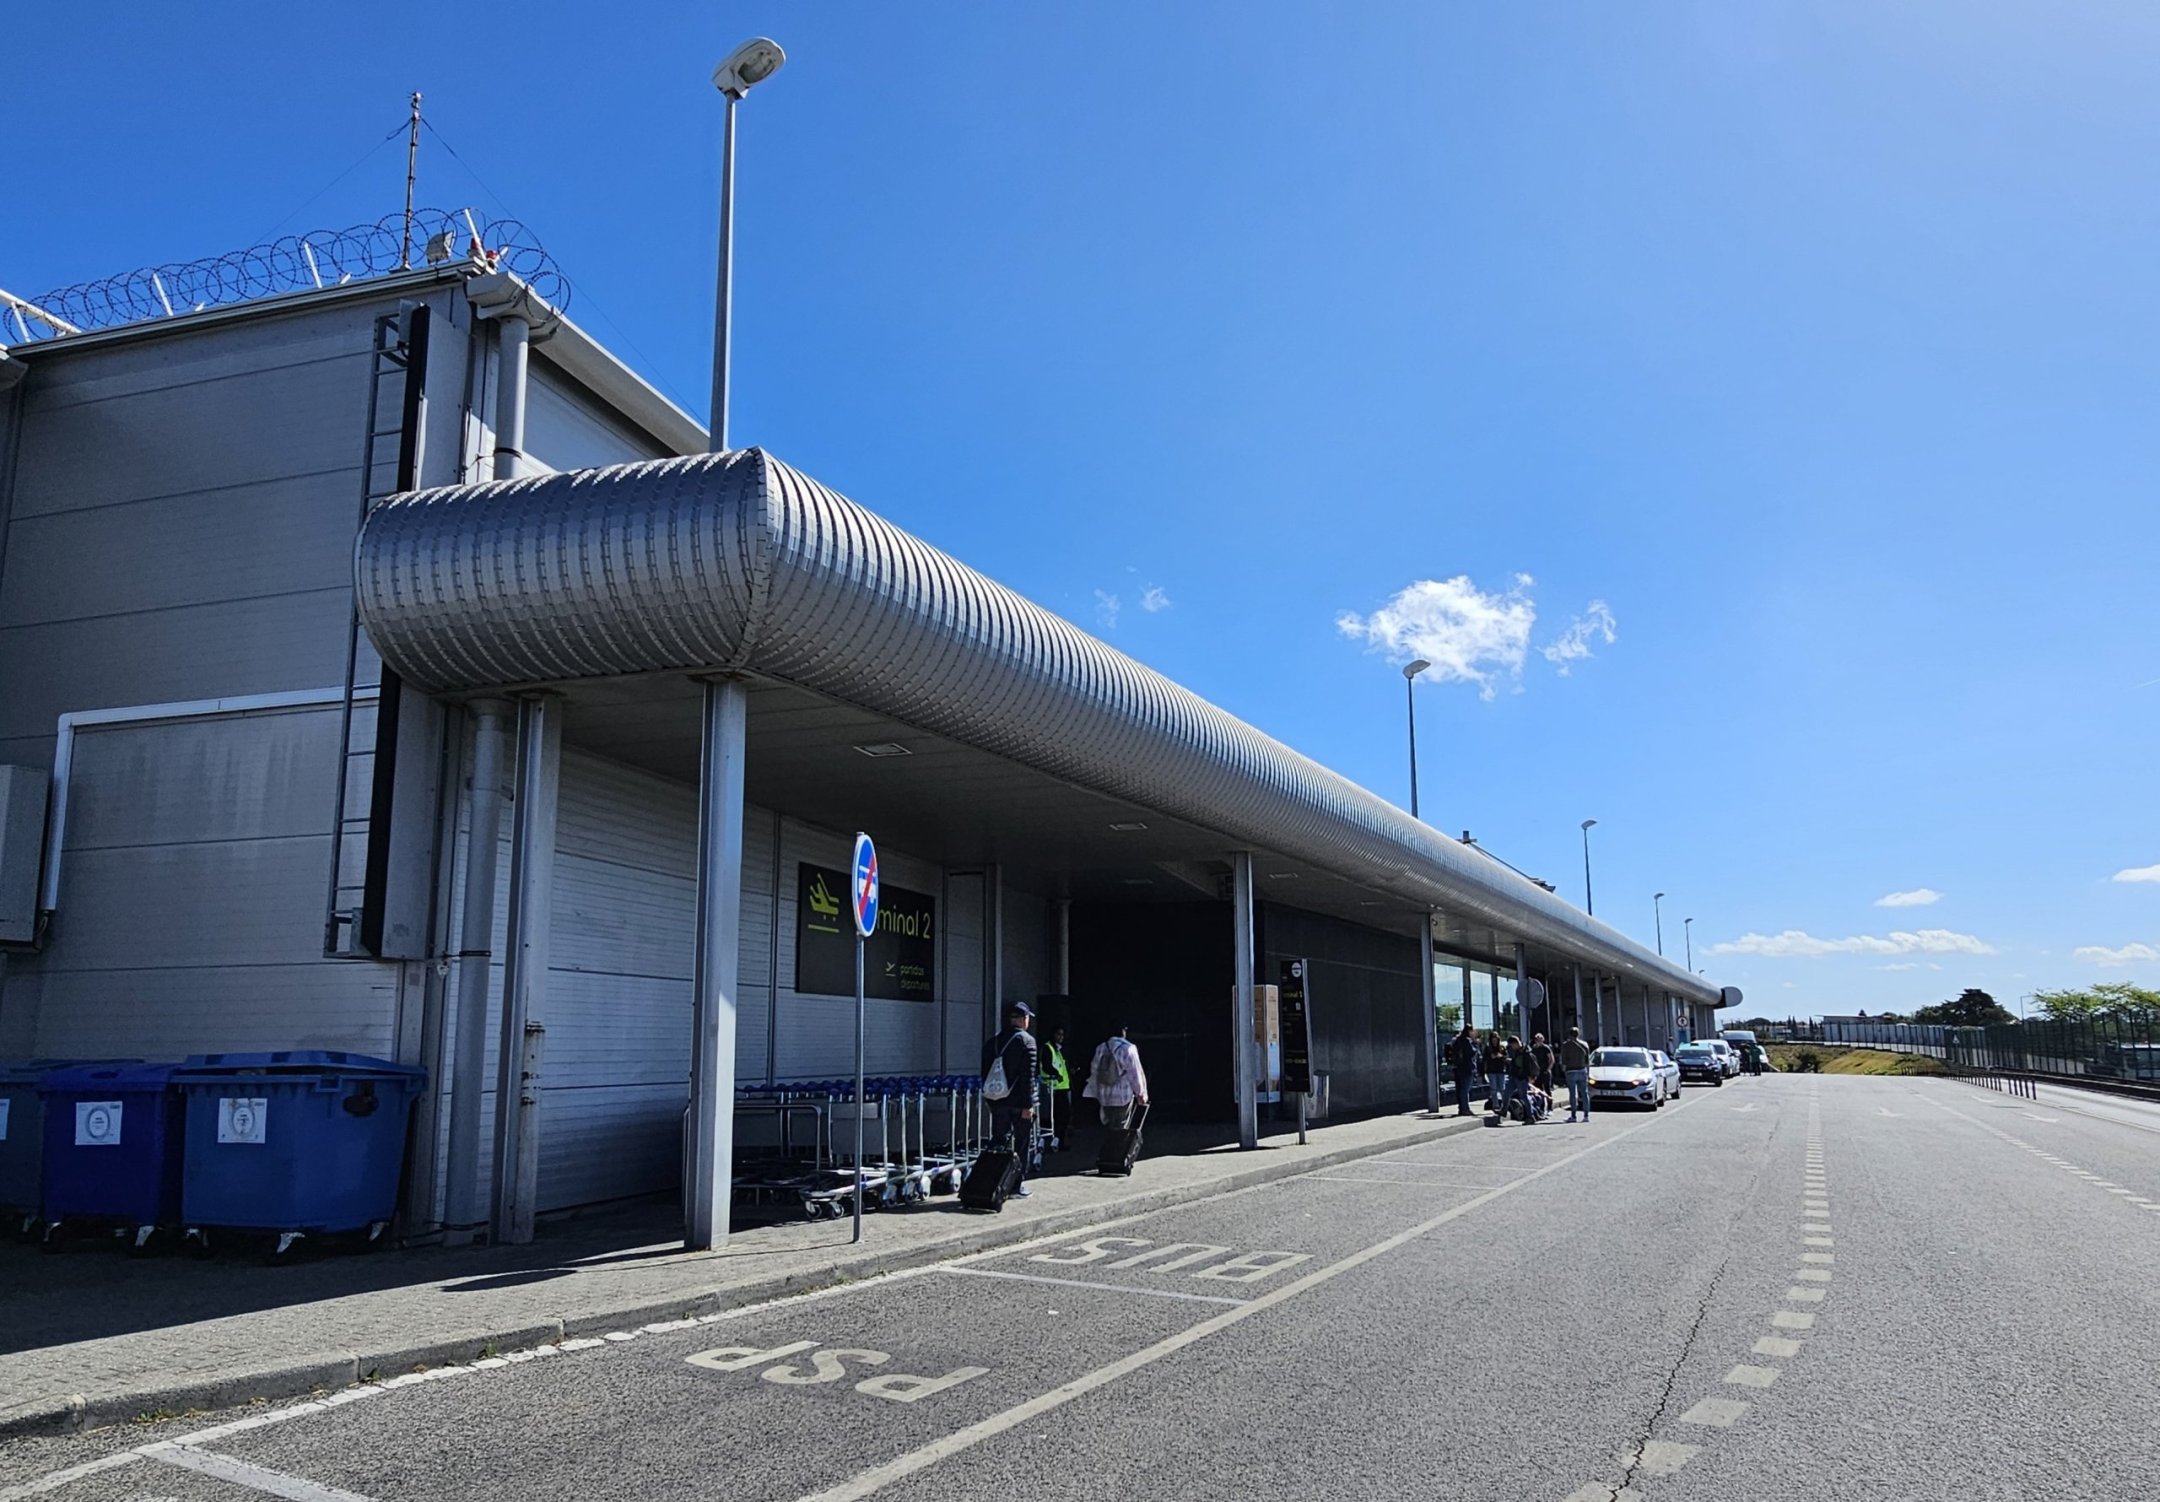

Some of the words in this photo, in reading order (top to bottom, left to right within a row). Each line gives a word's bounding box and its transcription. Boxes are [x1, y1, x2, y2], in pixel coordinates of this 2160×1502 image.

[877, 904, 919, 936] minal
[923, 912, 931, 939] 2
[1028, 1237, 1315, 1283] BUS
[685, 1340, 990, 1402] PSP
